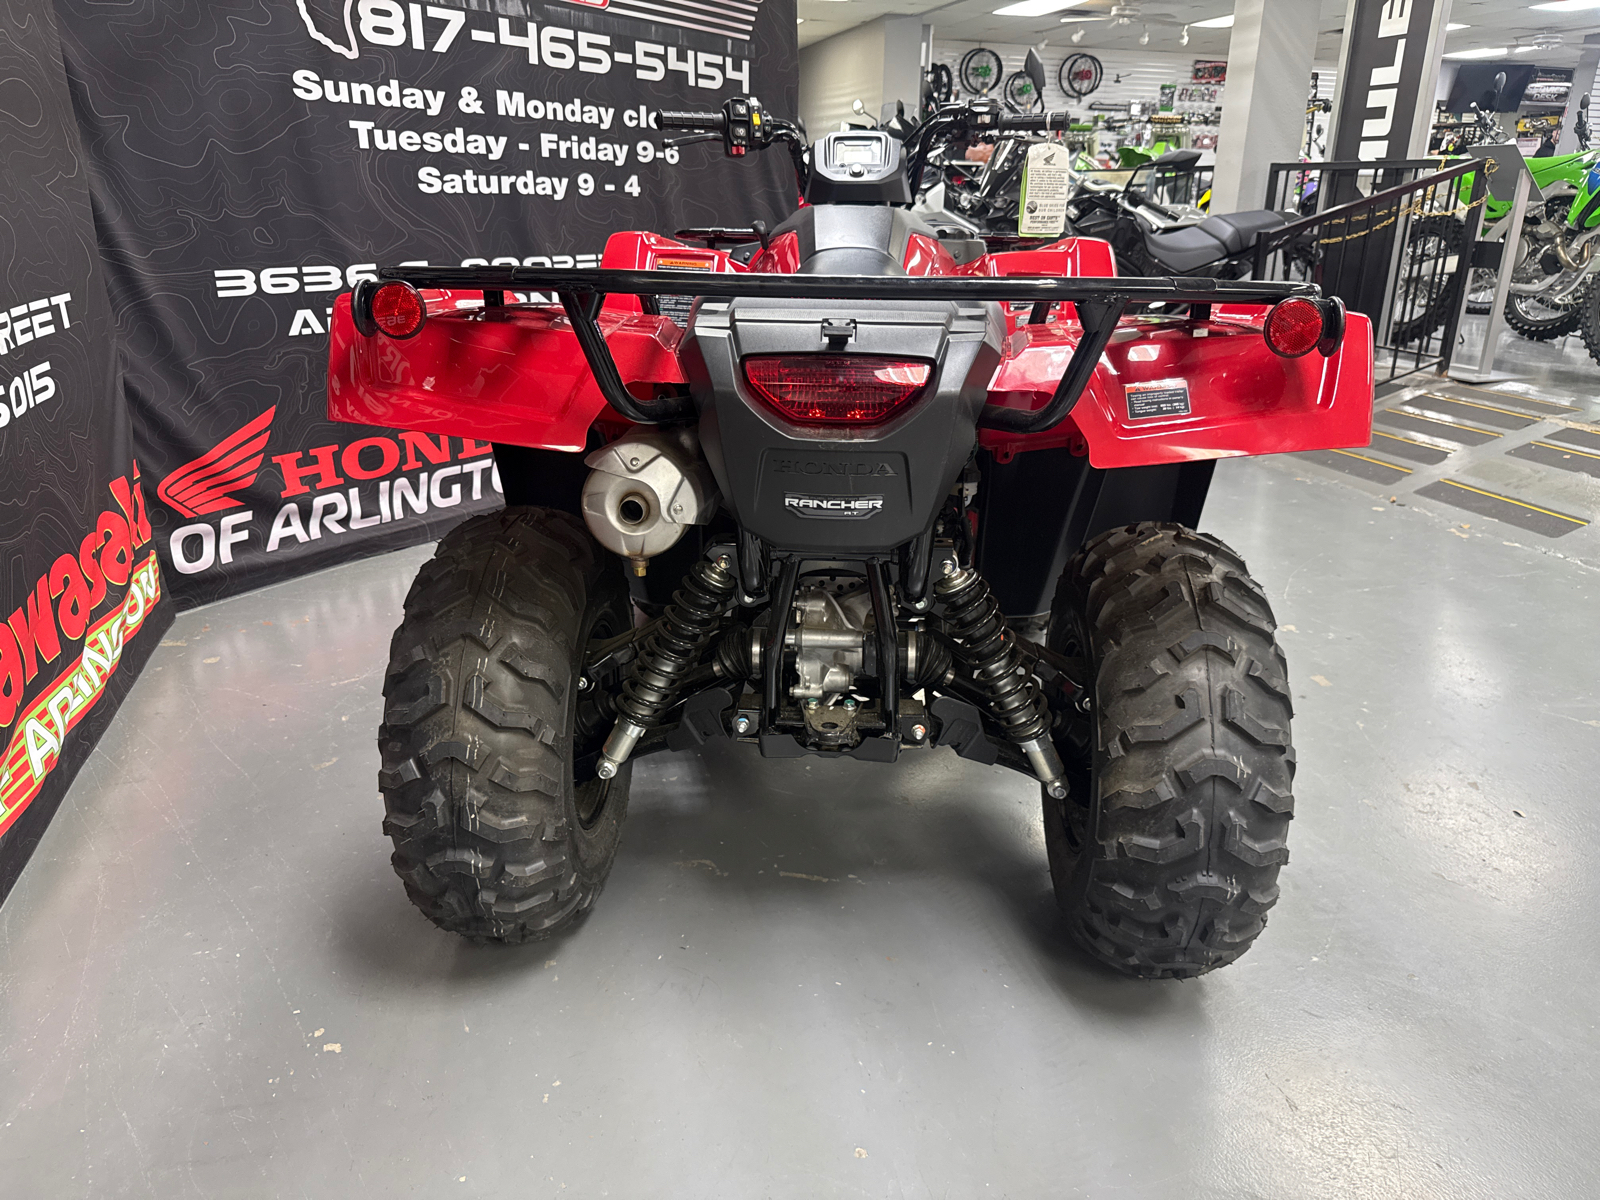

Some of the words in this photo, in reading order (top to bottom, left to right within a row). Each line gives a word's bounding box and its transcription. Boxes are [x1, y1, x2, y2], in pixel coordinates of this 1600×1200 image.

[357, 0, 750, 95] 817-465-5454
[292, 69, 446, 116] Sunday
[457, 86, 486, 115] &
[496, 89, 615, 130] Monday
[1532, 93, 1558, 102] DESK
[348, 119, 508, 161] Tuesday
[518, 143, 530, 151] -
[540, 132, 629, 167] Friday
[636, 140, 680, 165] 9-6
[417, 166, 569, 201] Saturday
[577, 172, 595, 197] 9
[624, 174, 641, 197] 4
[213, 263, 379, 301] 3636
[271, 430, 494, 499] HON
[772, 459, 899, 478] HONDA
[169, 510, 253, 575] OF
[266, 458, 504, 553] ARLINGT
[785, 497, 884, 510] RANCHER
